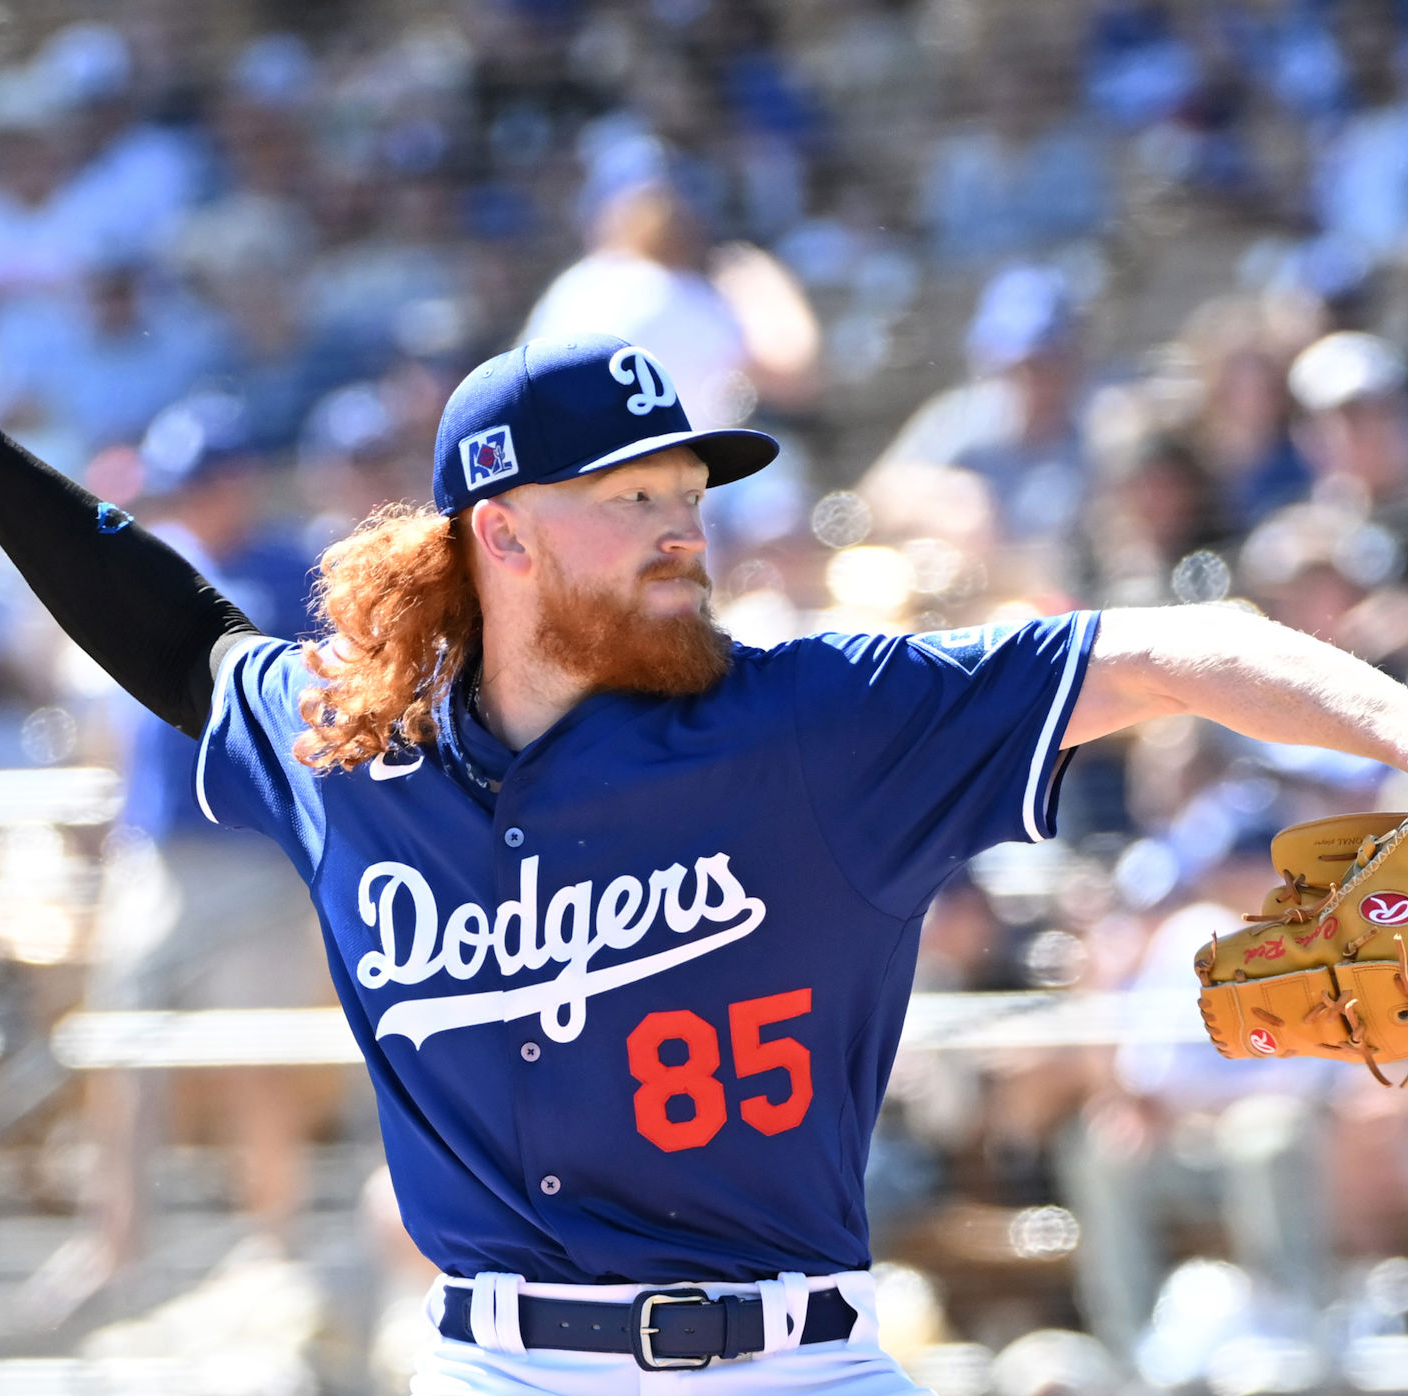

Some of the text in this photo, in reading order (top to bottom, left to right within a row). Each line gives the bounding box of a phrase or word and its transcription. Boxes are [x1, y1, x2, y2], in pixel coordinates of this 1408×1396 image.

[609, 346, 677, 416] D
[357, 852, 766, 1044] Dodgers
[626, 988, 813, 1152] 85
